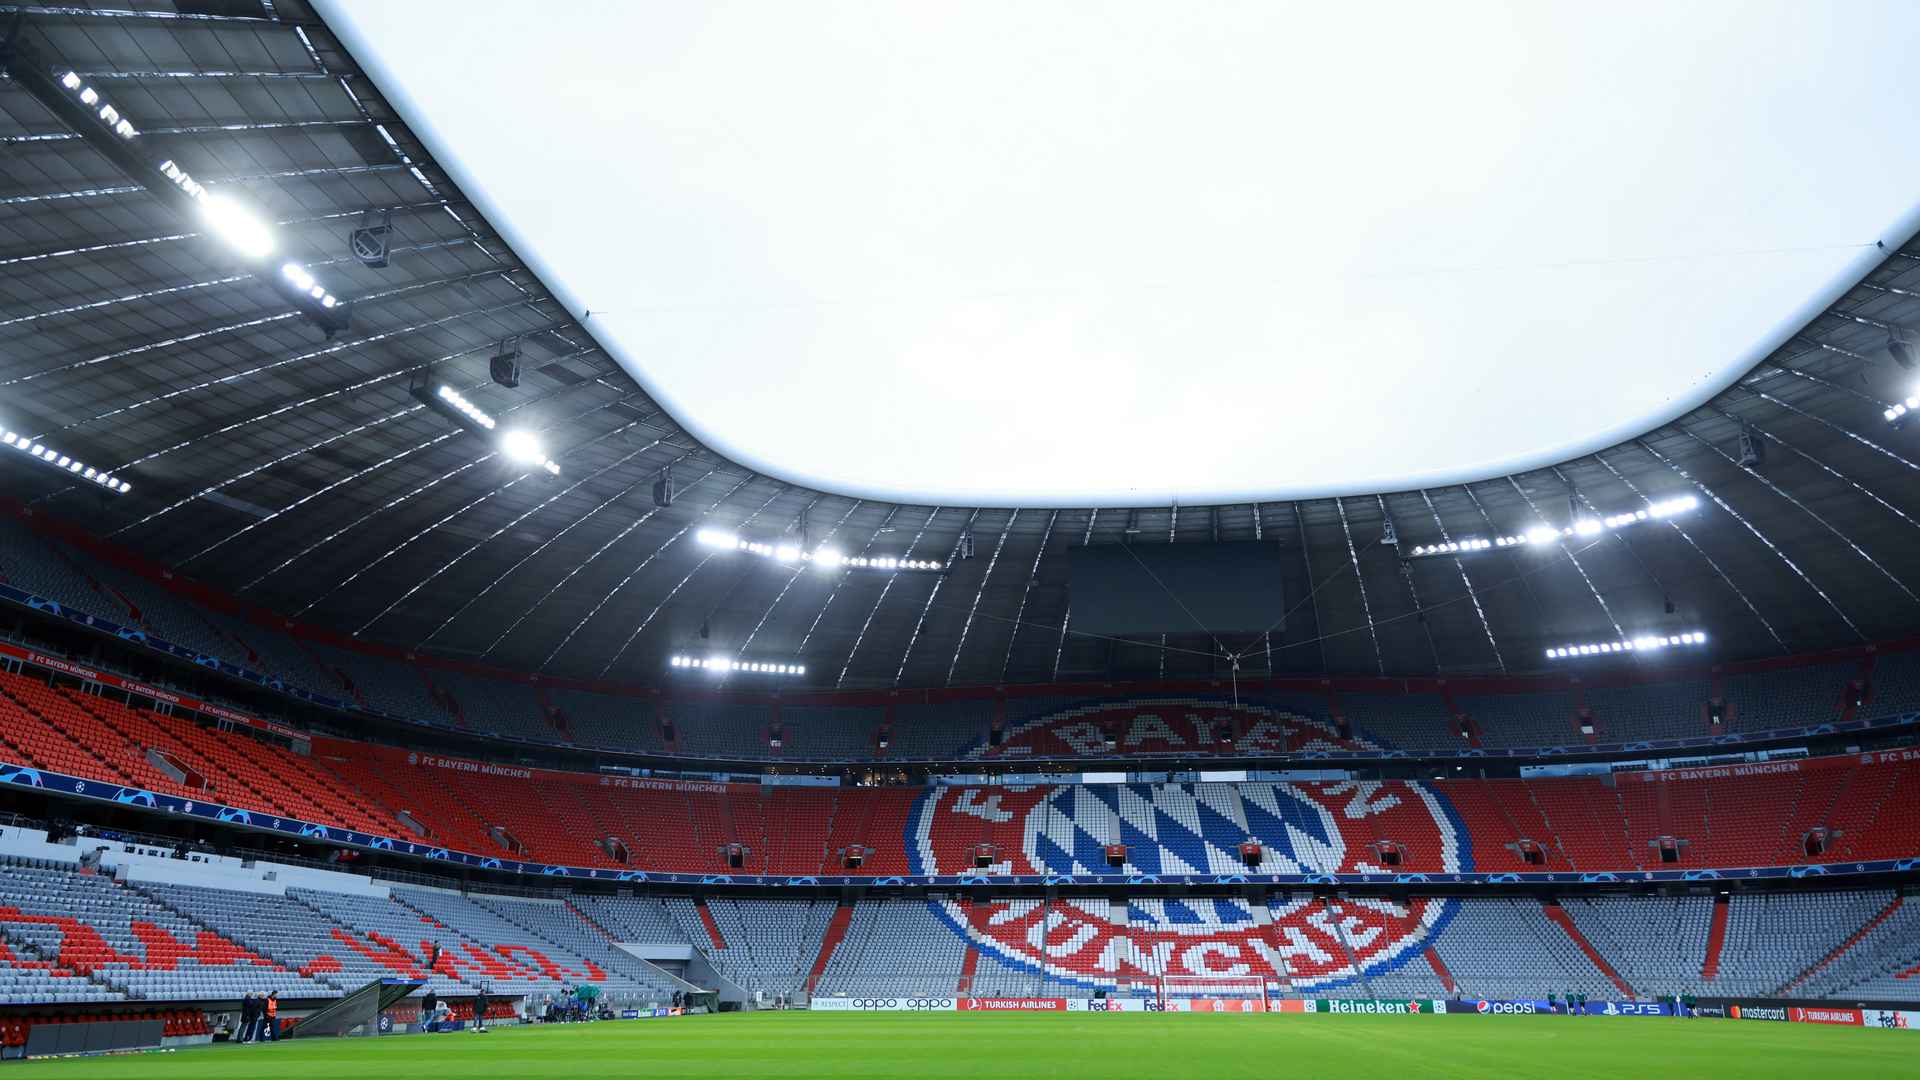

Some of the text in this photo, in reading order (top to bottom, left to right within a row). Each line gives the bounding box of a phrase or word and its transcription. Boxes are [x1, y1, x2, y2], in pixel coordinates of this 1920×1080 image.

[1880, 753, 1898, 765] FC
[422, 756, 532, 779] FC BAYERN MÜNCHEN
[1661, 761, 1800, 782] FC BAYERN MÜNCHEN
[615, 778, 728, 794] FC BAYERN MÜNCHEN
[853, 998, 897, 1011] oppo
[907, 998, 952, 1011] oppo
[985, 1000, 1057, 1009] TURKISH AIRLINES
[1087, 999, 1124, 1012] FedEx
[1143, 999, 1179, 1012] FedEx
[1329, 999, 1407, 1014] Heineken
[1493, 1000, 1536, 1015] pepsi
[1622, 1004, 1661, 1014] PS5
[1741, 1006, 1785, 1020] mastercard
[1807, 1011, 1854, 1022] TURKISH AIRLINES
[1878, 1011, 1908, 1029] FedEx
